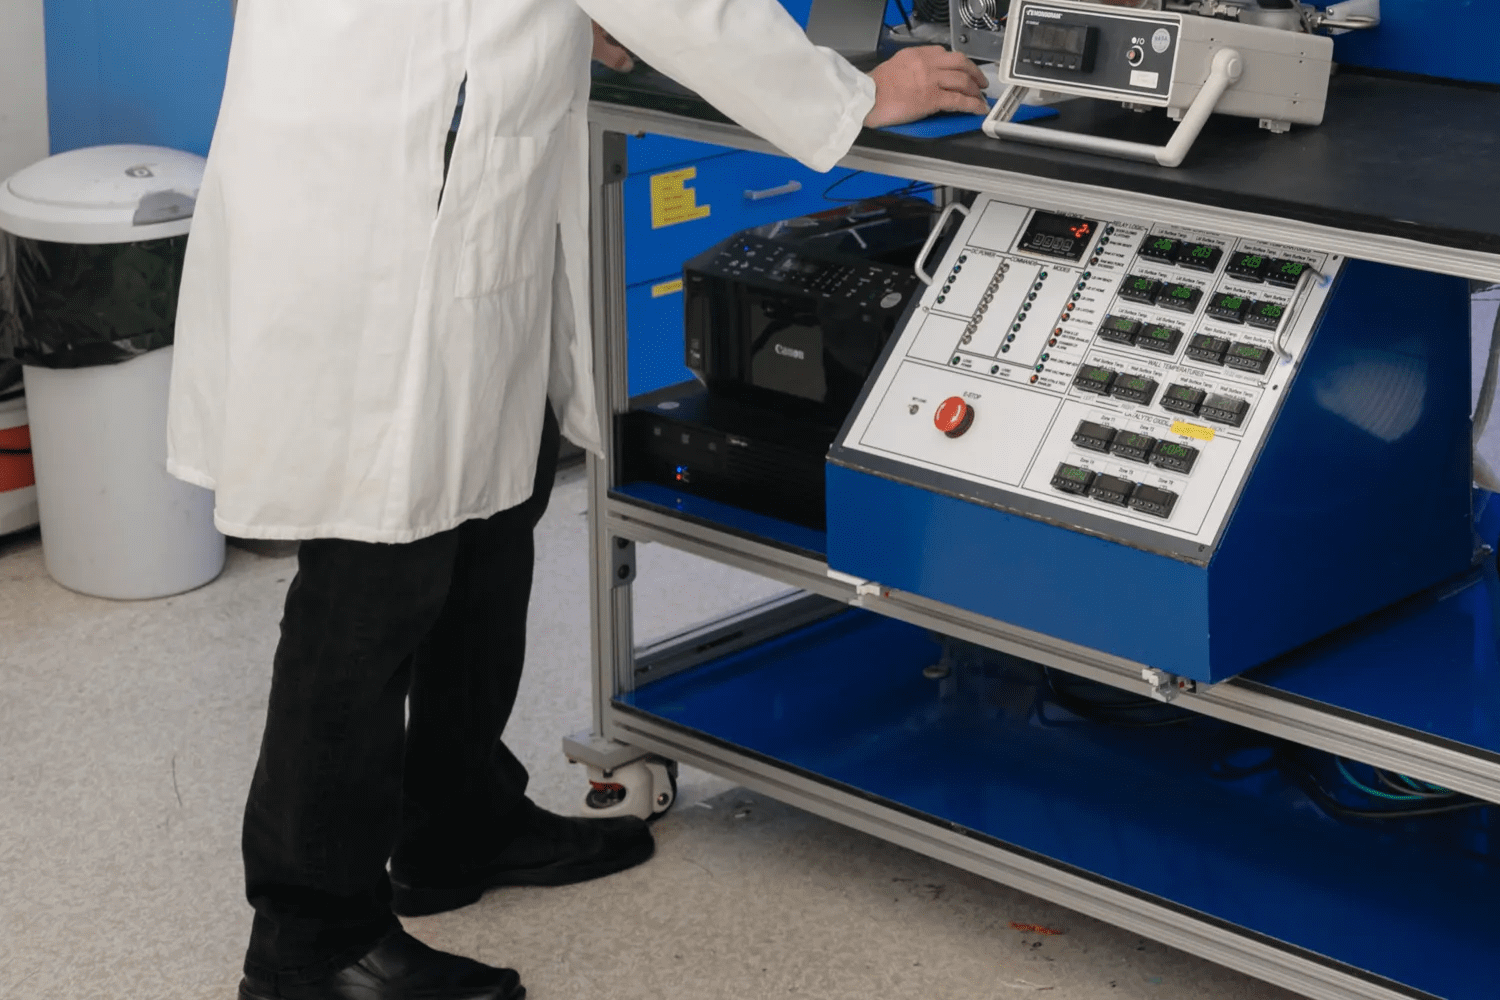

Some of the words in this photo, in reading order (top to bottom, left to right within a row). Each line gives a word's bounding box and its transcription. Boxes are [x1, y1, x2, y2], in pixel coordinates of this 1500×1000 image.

[980, 250, 996, 258] POWER
[1053, 265, 1071, 273] MODES
[775, 344, 804, 360] Canon
[1148, 360, 1162, 368] WALL
[1163, 362, 1204, 376] TEMPERATURES
